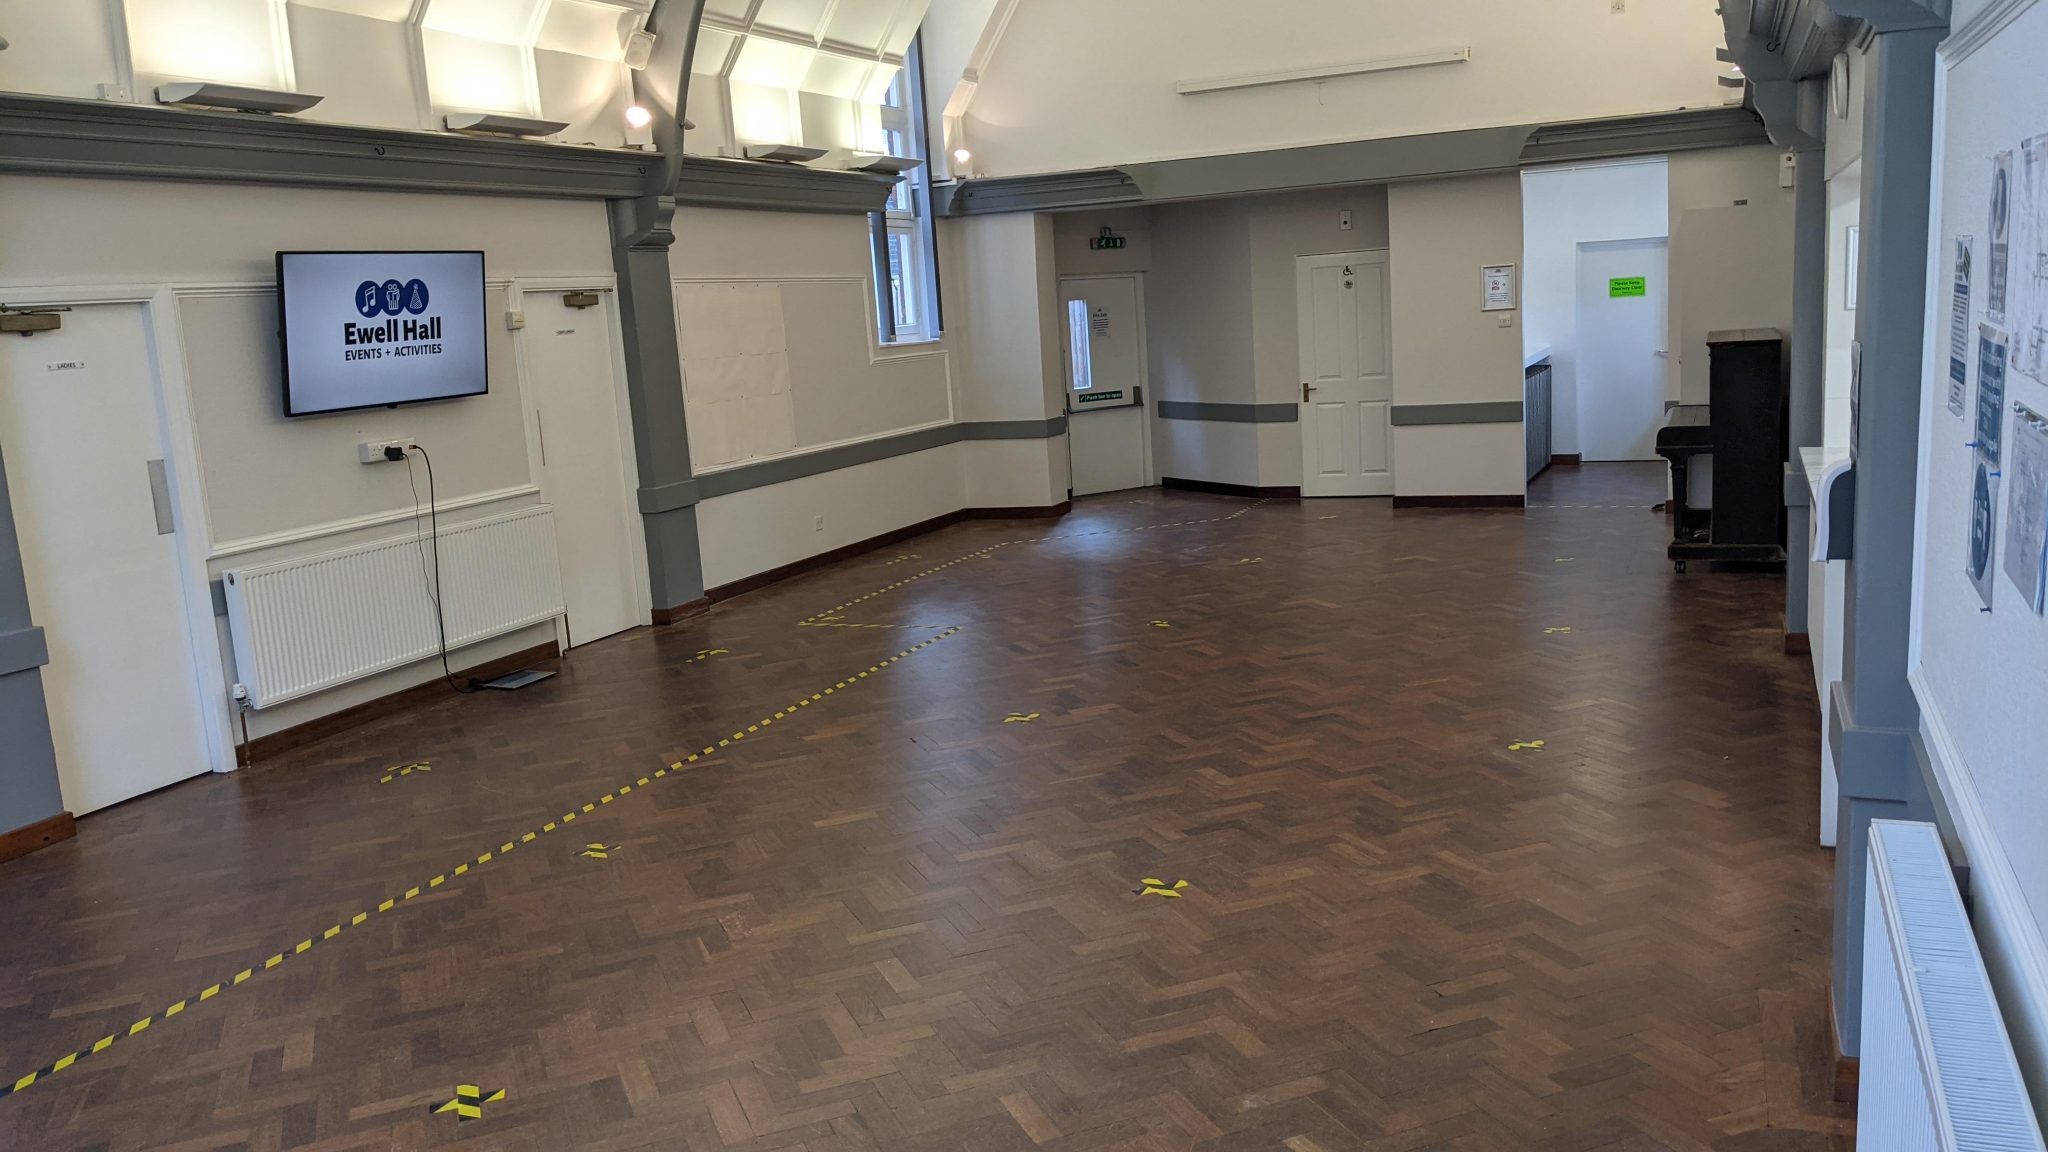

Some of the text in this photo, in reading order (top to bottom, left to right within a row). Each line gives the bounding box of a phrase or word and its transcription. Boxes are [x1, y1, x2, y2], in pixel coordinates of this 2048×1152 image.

[344, 316, 441, 345] Ewell Hall
[345, 343, 442, 361] EVENTS + ACTIVITIES
